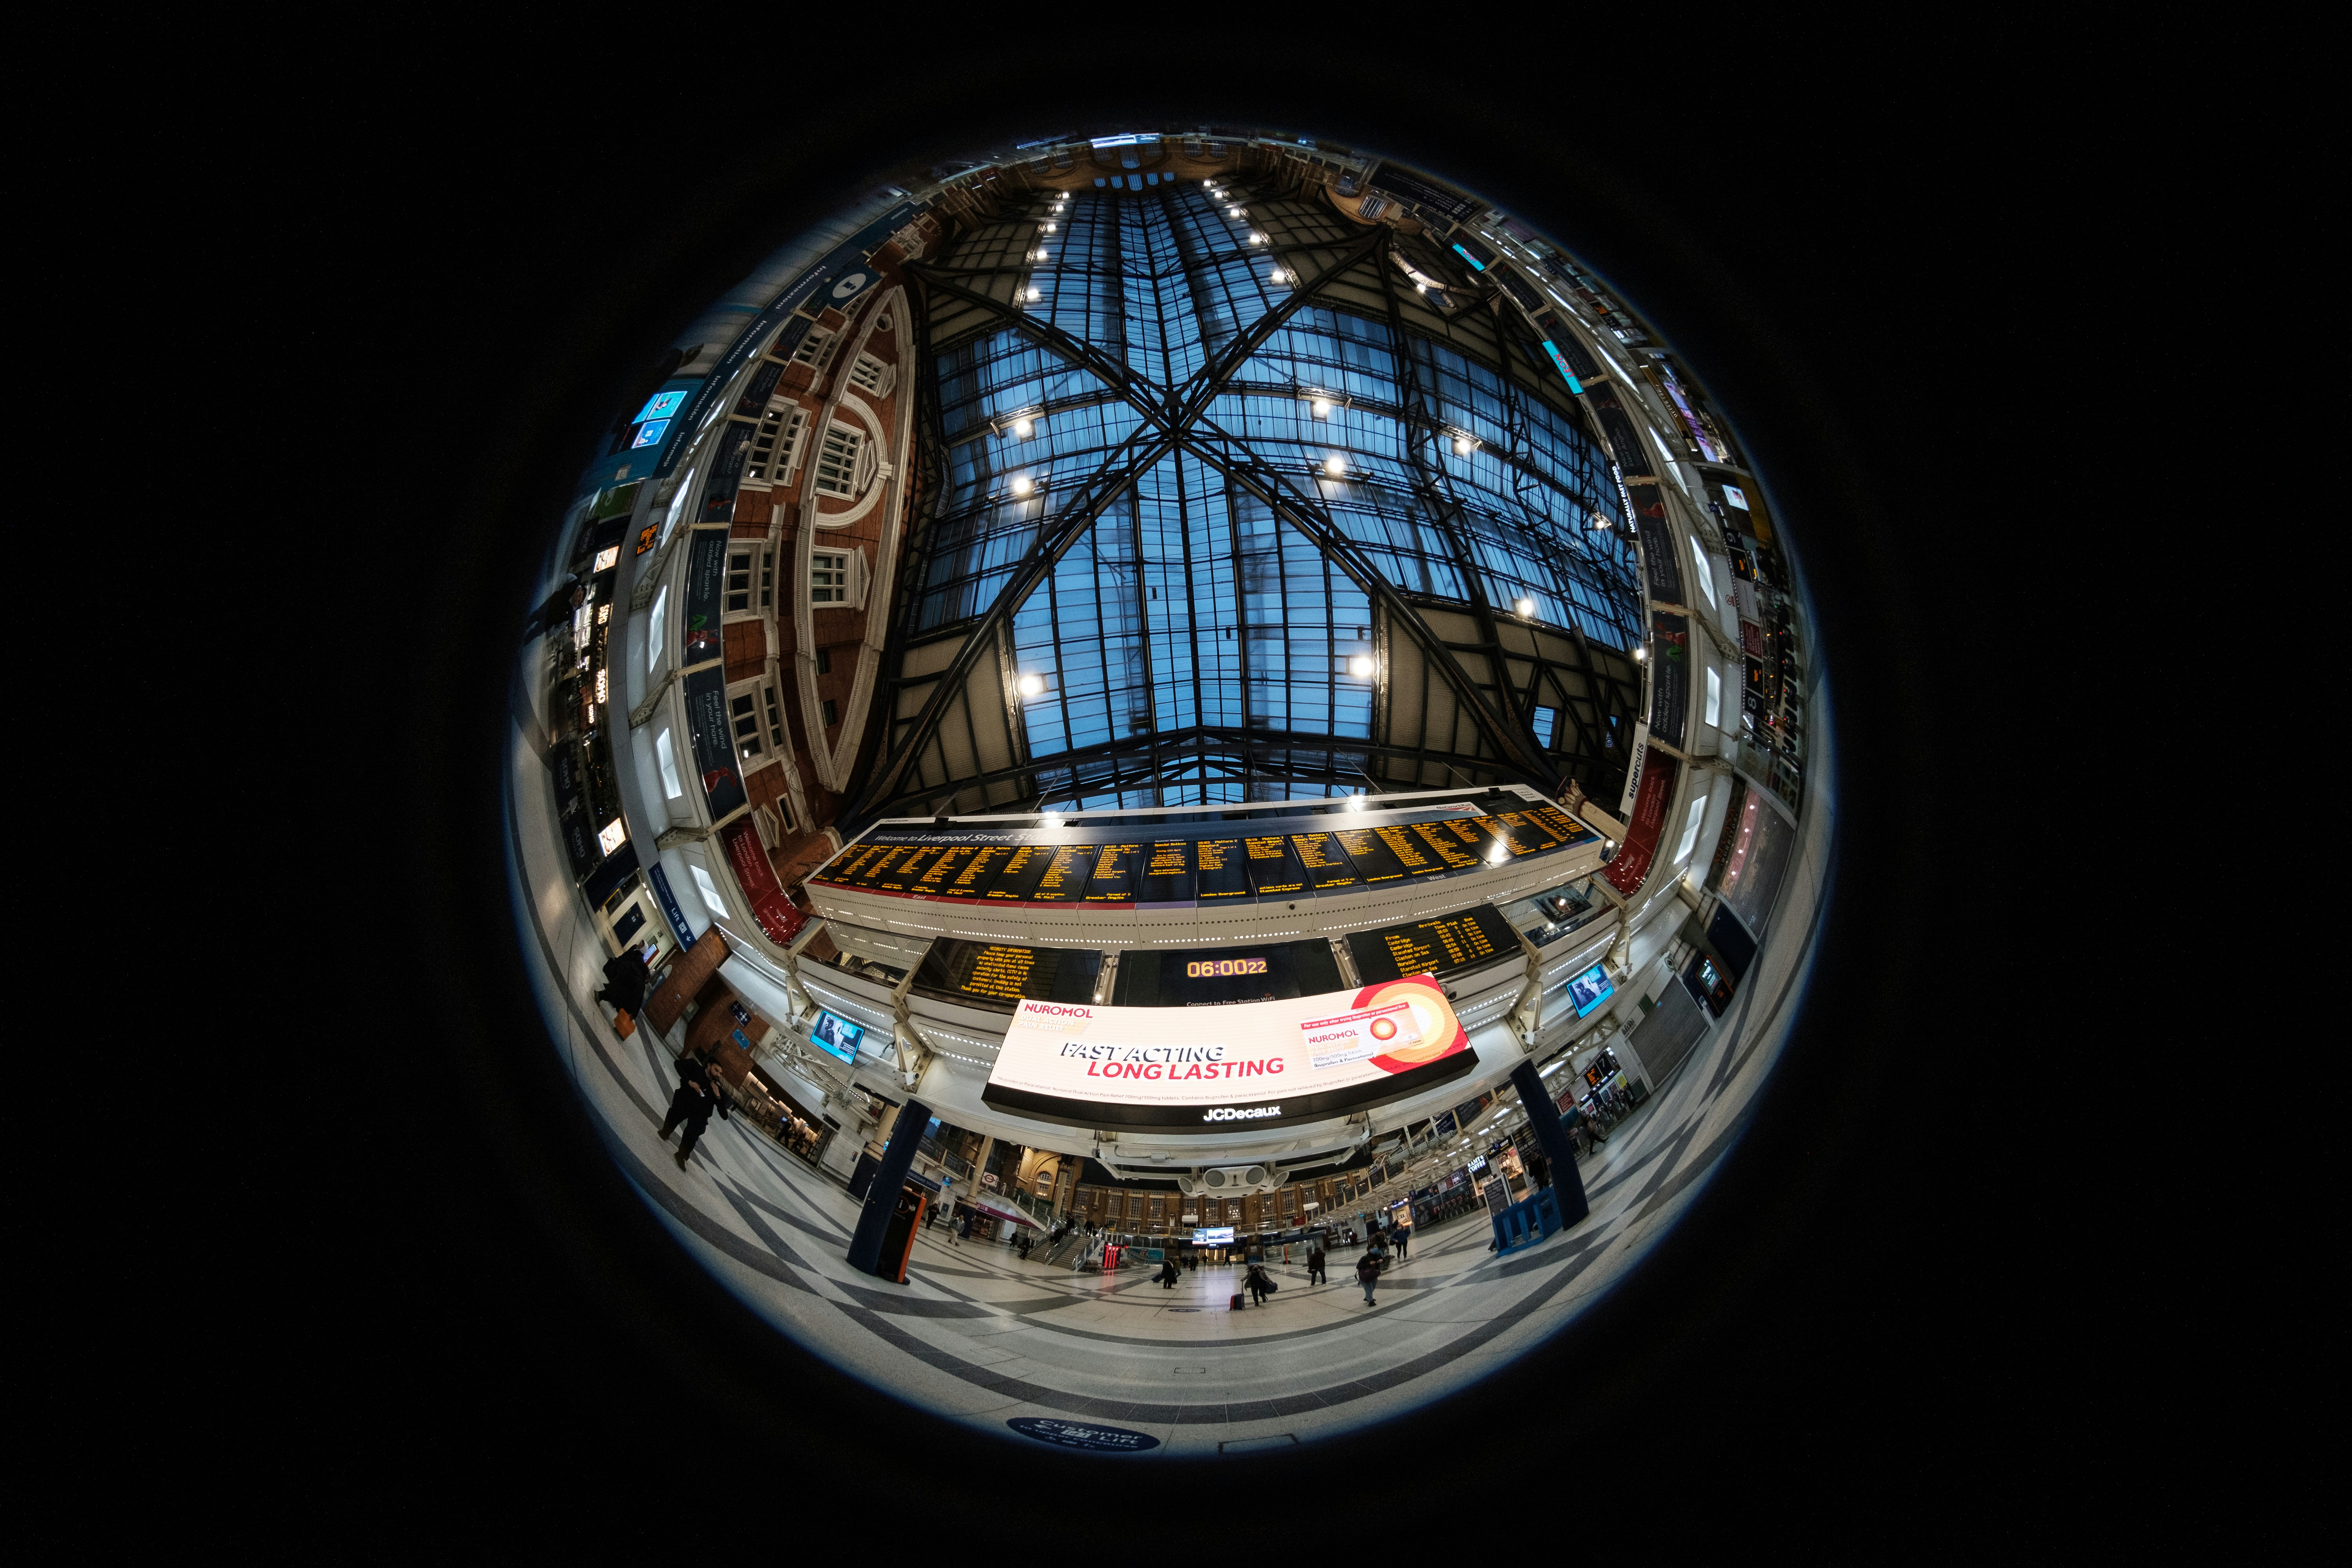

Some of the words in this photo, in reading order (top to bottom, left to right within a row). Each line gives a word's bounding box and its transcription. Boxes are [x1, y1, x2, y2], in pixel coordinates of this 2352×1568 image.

[775, 265, 826, 310] Informazioni
[727, 320, 767, 365] Information
[1553, 352, 1575, 377] LEON
[688, 375, 721, 421] Información
[663, 432, 685, 467] Informacja
[1612, 466, 1621, 483] FOOD
[1618, 484, 1626, 497] FAST
[1622, 498, 1637, 533] NATURALLY
[1644, 530, 1653, 550] wind
[597, 669, 606, 704] SOHO
[1748, 697, 1757, 710] 8
[719, 728, 727, 749] wind
[1628, 742, 1644, 799] supercuts
[1641, 791, 1651, 822] Welcome
[1646, 815, 1650, 826] to
[1648, 794, 1656, 815] London
[1650, 799, 1661, 829] Liverpool
[574, 826, 585, 858] SOHO
[917, 834, 973, 843] Liverpool
[732, 838, 746, 867] Liverpool
[744, 868, 755, 888] Street
[740, 843, 752, 867] London
[743, 831, 757, 861] Welcome
[755, 862, 764, 877] back
[671, 907, 680, 922] Lift
[1020, 1015, 1042, 1023] DUAL
[1044, 1017, 1076, 1026] ACTION
[1024, 1003, 1093, 1018] NUROMOL
[1018, 1021, 1038, 1030] PAIN
[1039, 1024, 1065, 1032] RELIEF
[1308, 1029, 1359, 1044] NUROMOL
[1060, 1042, 1122, 1061] FAST
[1123, 1046, 1225, 1063] ACTING
[1313, 1053, 1347, 1062] 200mg/500mg
[1344, 1052, 1374, 1062] Paracetamol
[1087, 1061, 1163, 1080] LONG
[1168, 1057, 1284, 1080] LASTING
[1203, 1106, 1281, 1122] JCDecaux
[1468, 1160, 1486, 1173] COFFEE
[1471, 1156, 1481, 1165] AMT
[1034, 1429, 1069, 1439] upper
[1073, 1437, 1138, 1448] concourse
[1039, 1420, 1143, 1439] Customer
[1099, 1436, 1138, 1445] Lift
